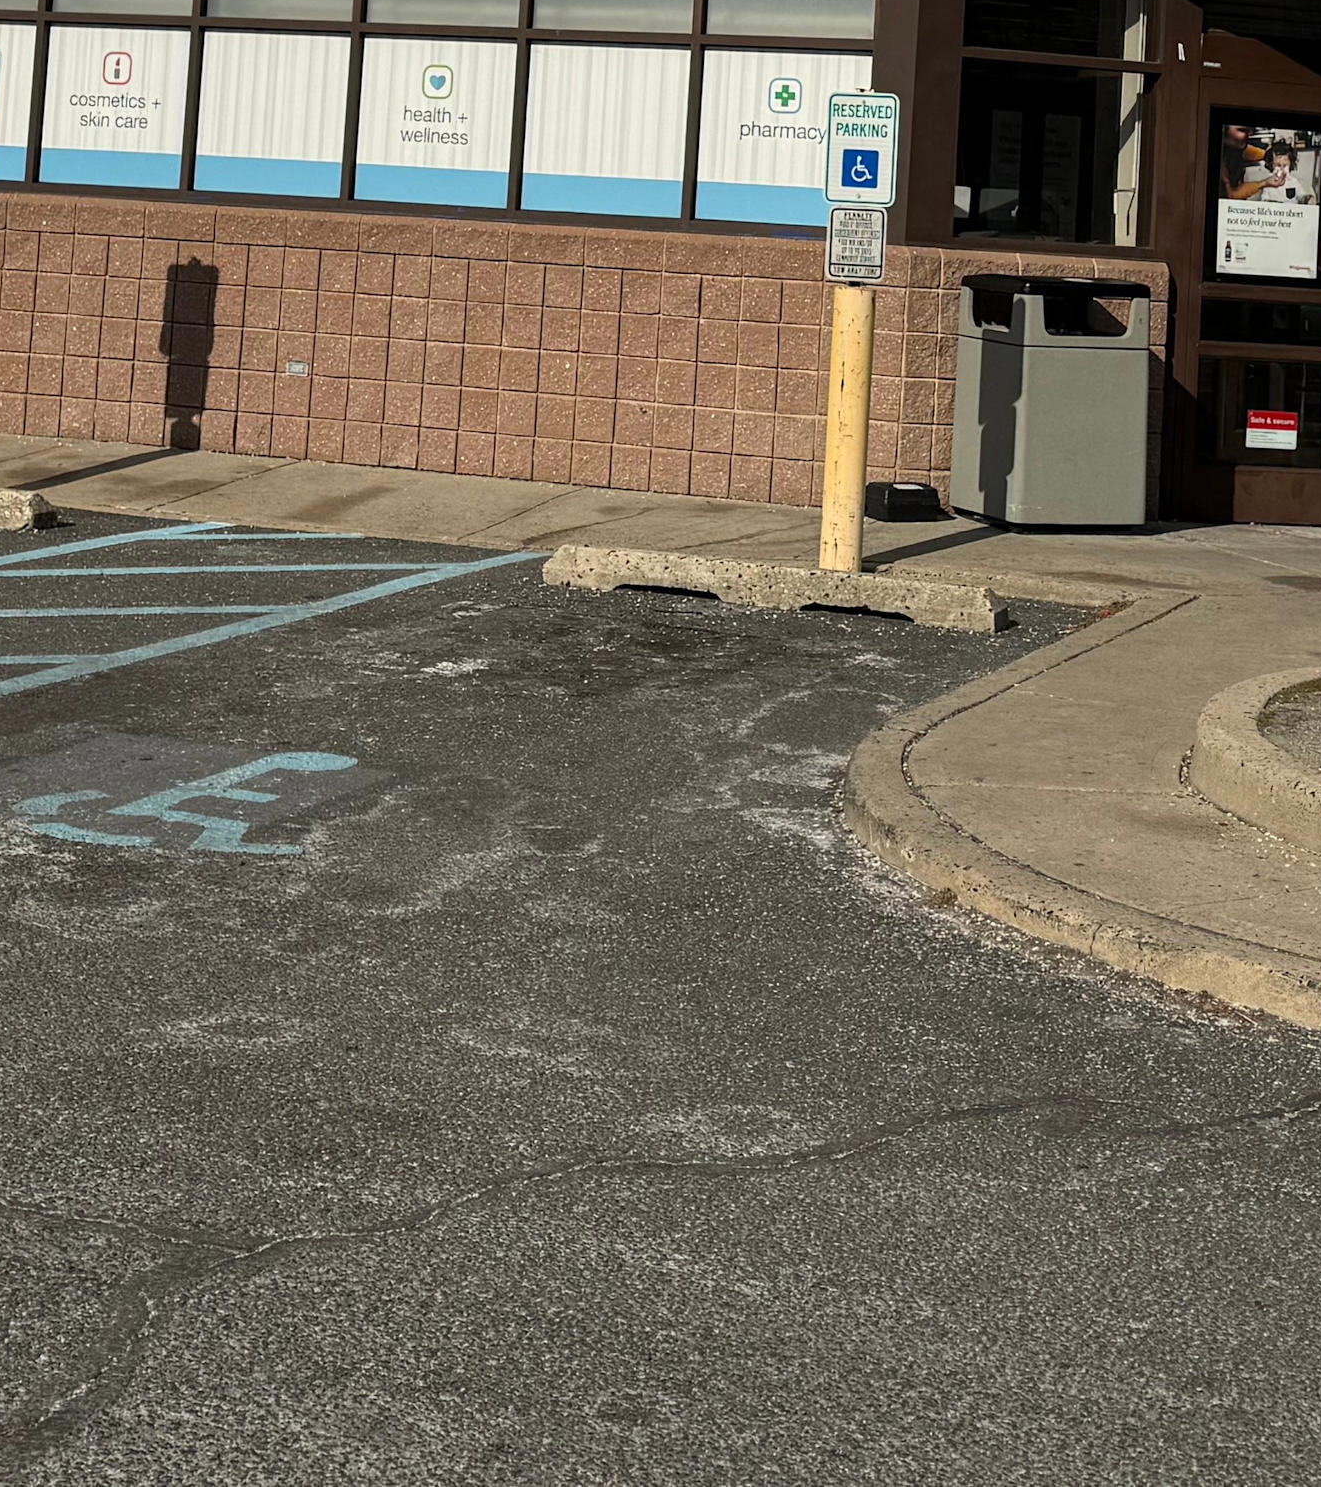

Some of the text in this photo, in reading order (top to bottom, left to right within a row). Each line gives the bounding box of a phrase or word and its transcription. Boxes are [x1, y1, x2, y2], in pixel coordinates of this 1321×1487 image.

[69, 93, 161, 109] cosmetics +
[80, 111, 148, 129] skin care
[403, 105, 468, 123] health +
[833, 104, 893, 119] RESERVED
[400, 127, 469, 145] wellness
[740, 121, 826, 145] pharmacy
[836, 123, 888, 138] PARKING
[1247, 218, 1260, 226] feel
[1261, 220, 1277, 228] your
[1278, 220, 1291, 228] best
